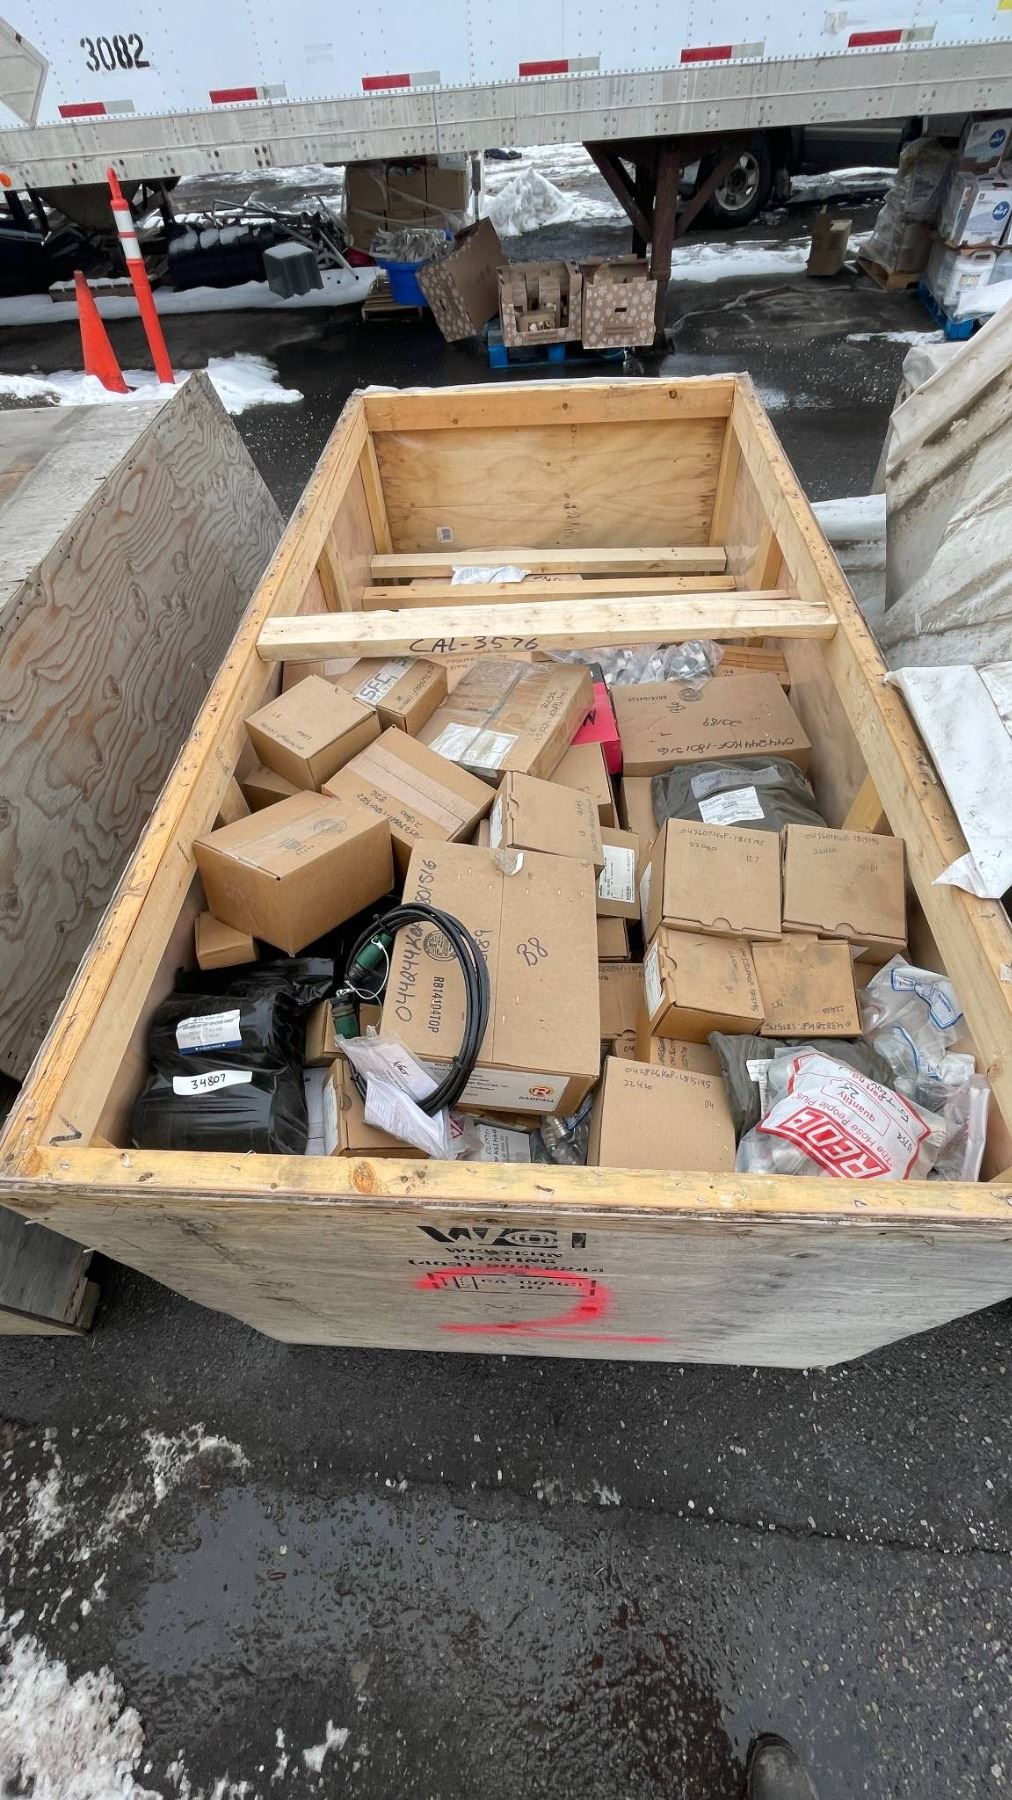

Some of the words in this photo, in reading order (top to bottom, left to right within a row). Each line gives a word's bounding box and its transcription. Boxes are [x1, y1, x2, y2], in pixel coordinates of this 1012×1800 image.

[80, 33, 150, 72] 3082
[410, 636, 539, 654] CAL-3576
[516, 936, 549, 967] B8
[427, 976, 446, 1034] RB14104TOP
[191, 1073, 227, 1090] 34807
[818, 1101, 852, 1127] People
[837, 1091, 877, 1124] quantity
[852, 1124, 877, 1147] Hose
[445, 1248, 563, 1258] WESTERN
[454, 1255, 556, 1264] CRATING
